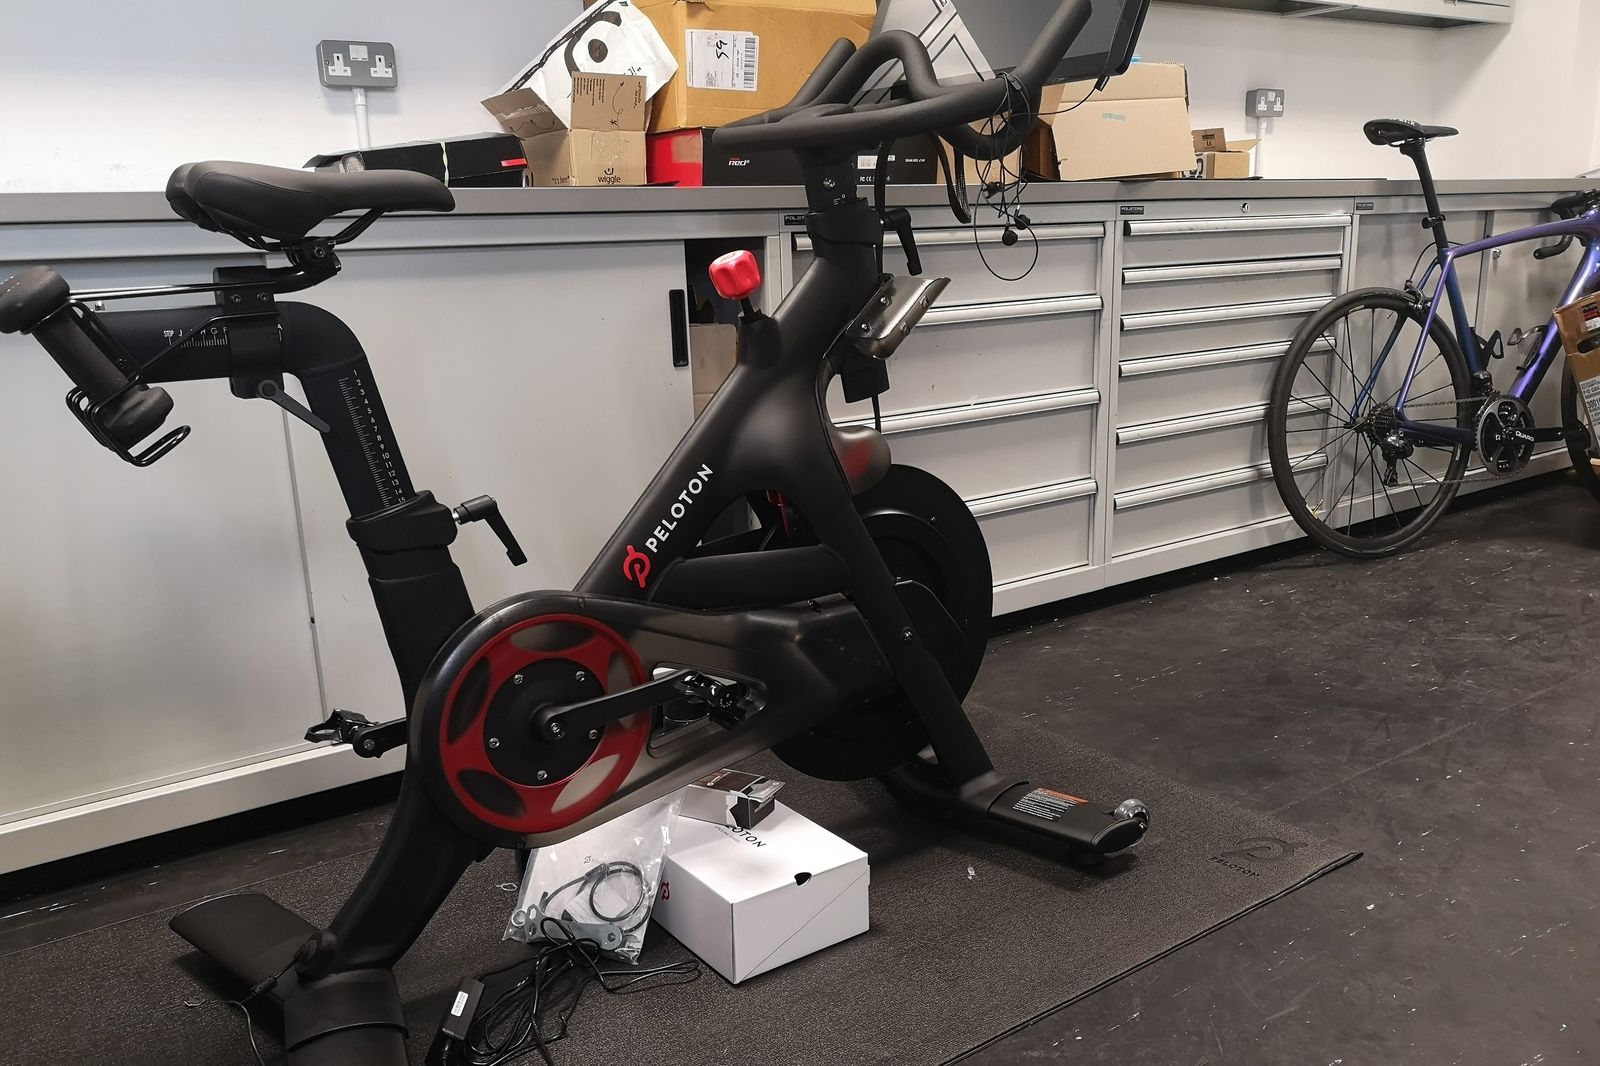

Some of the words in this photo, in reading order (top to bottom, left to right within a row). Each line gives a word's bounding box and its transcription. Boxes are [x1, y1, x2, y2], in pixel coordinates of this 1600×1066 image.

[598, 176, 621, 184] wiggle
[367, 407, 373, 415] 5
[370, 416, 376, 424] 6
[373, 425, 378, 433] 7
[376, 434, 382, 442] 8
[382, 452, 390, 460] 10
[388, 469, 396, 478] 12
[391, 478, 400, 486] 13
[394, 488, 403, 496] 14
[398, 496, 406, 504] 15
[645, 463, 714, 553] PELOTON
[1210, 856, 1260, 877] PELOTON
